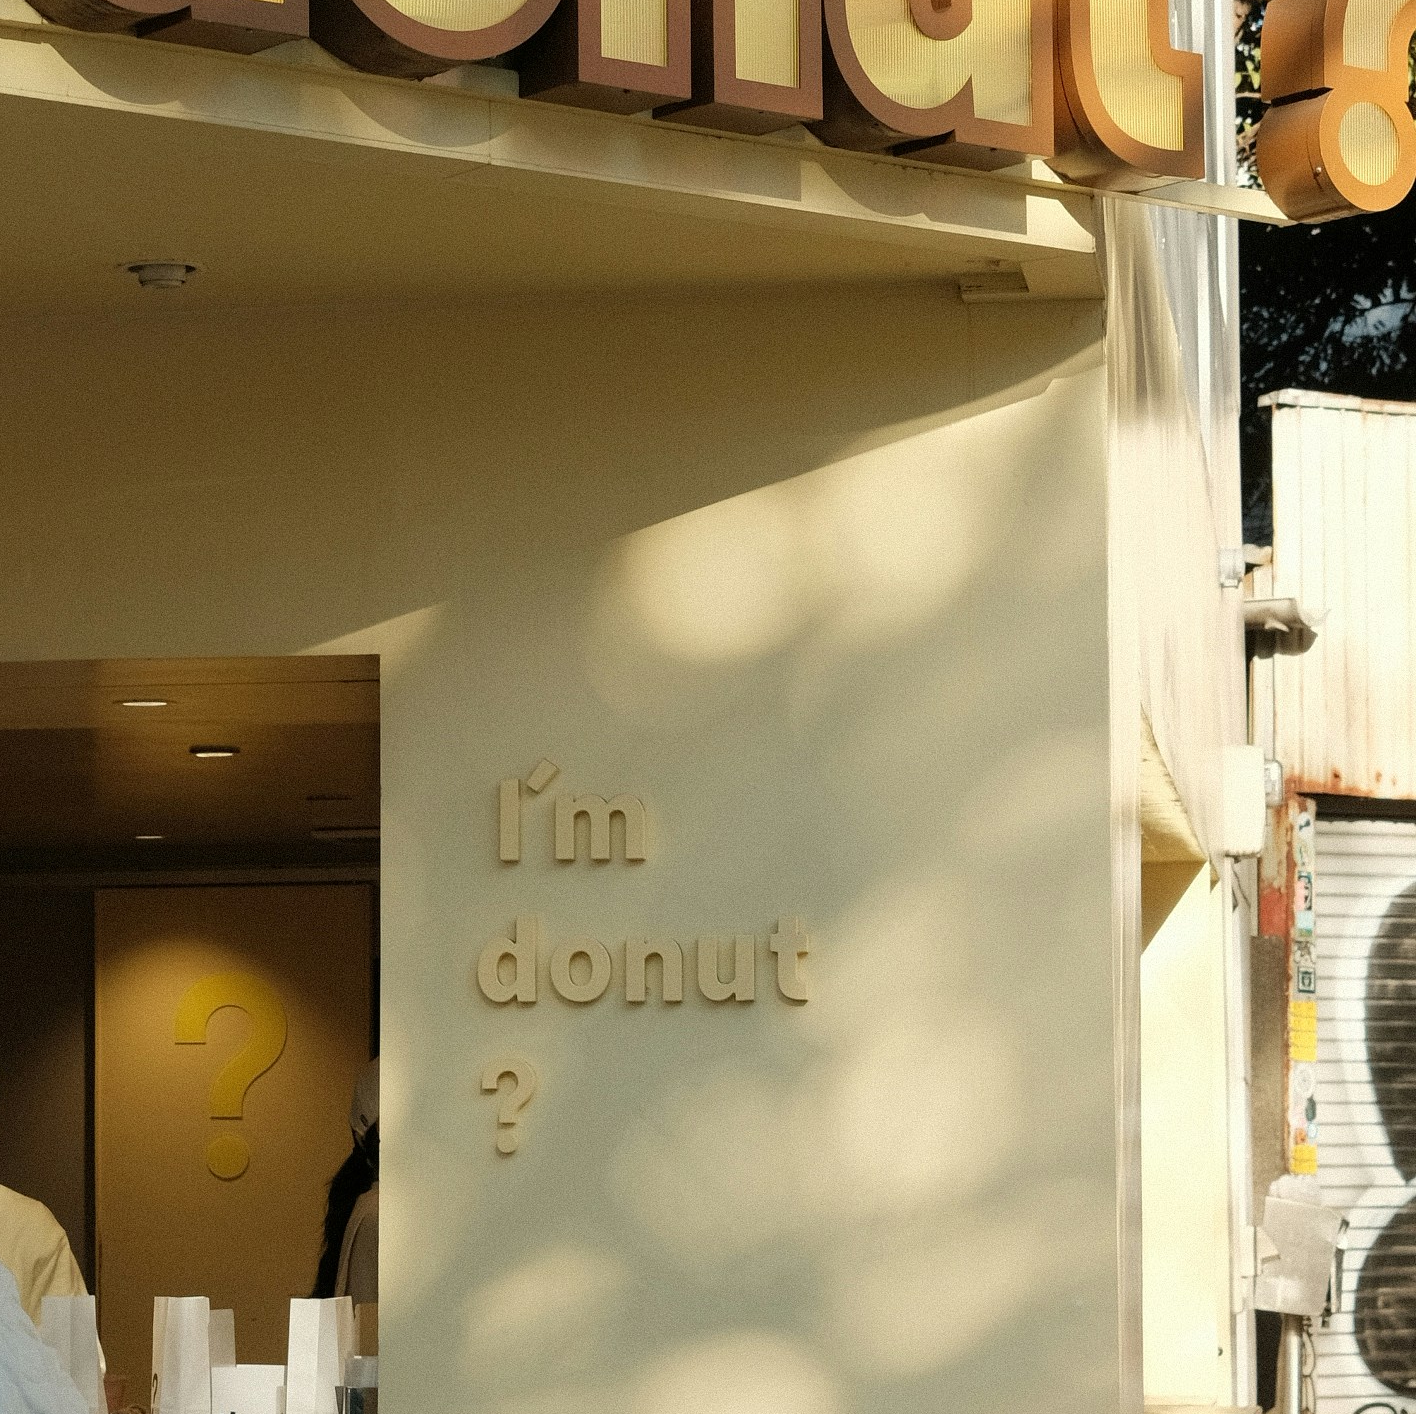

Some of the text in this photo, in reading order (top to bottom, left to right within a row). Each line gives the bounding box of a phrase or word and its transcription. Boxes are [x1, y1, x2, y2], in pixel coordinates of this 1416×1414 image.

[499, 758, 646, 863] I'm
[477, 915, 809, 1006] donut
[481, 1057, 538, 1154] ?
